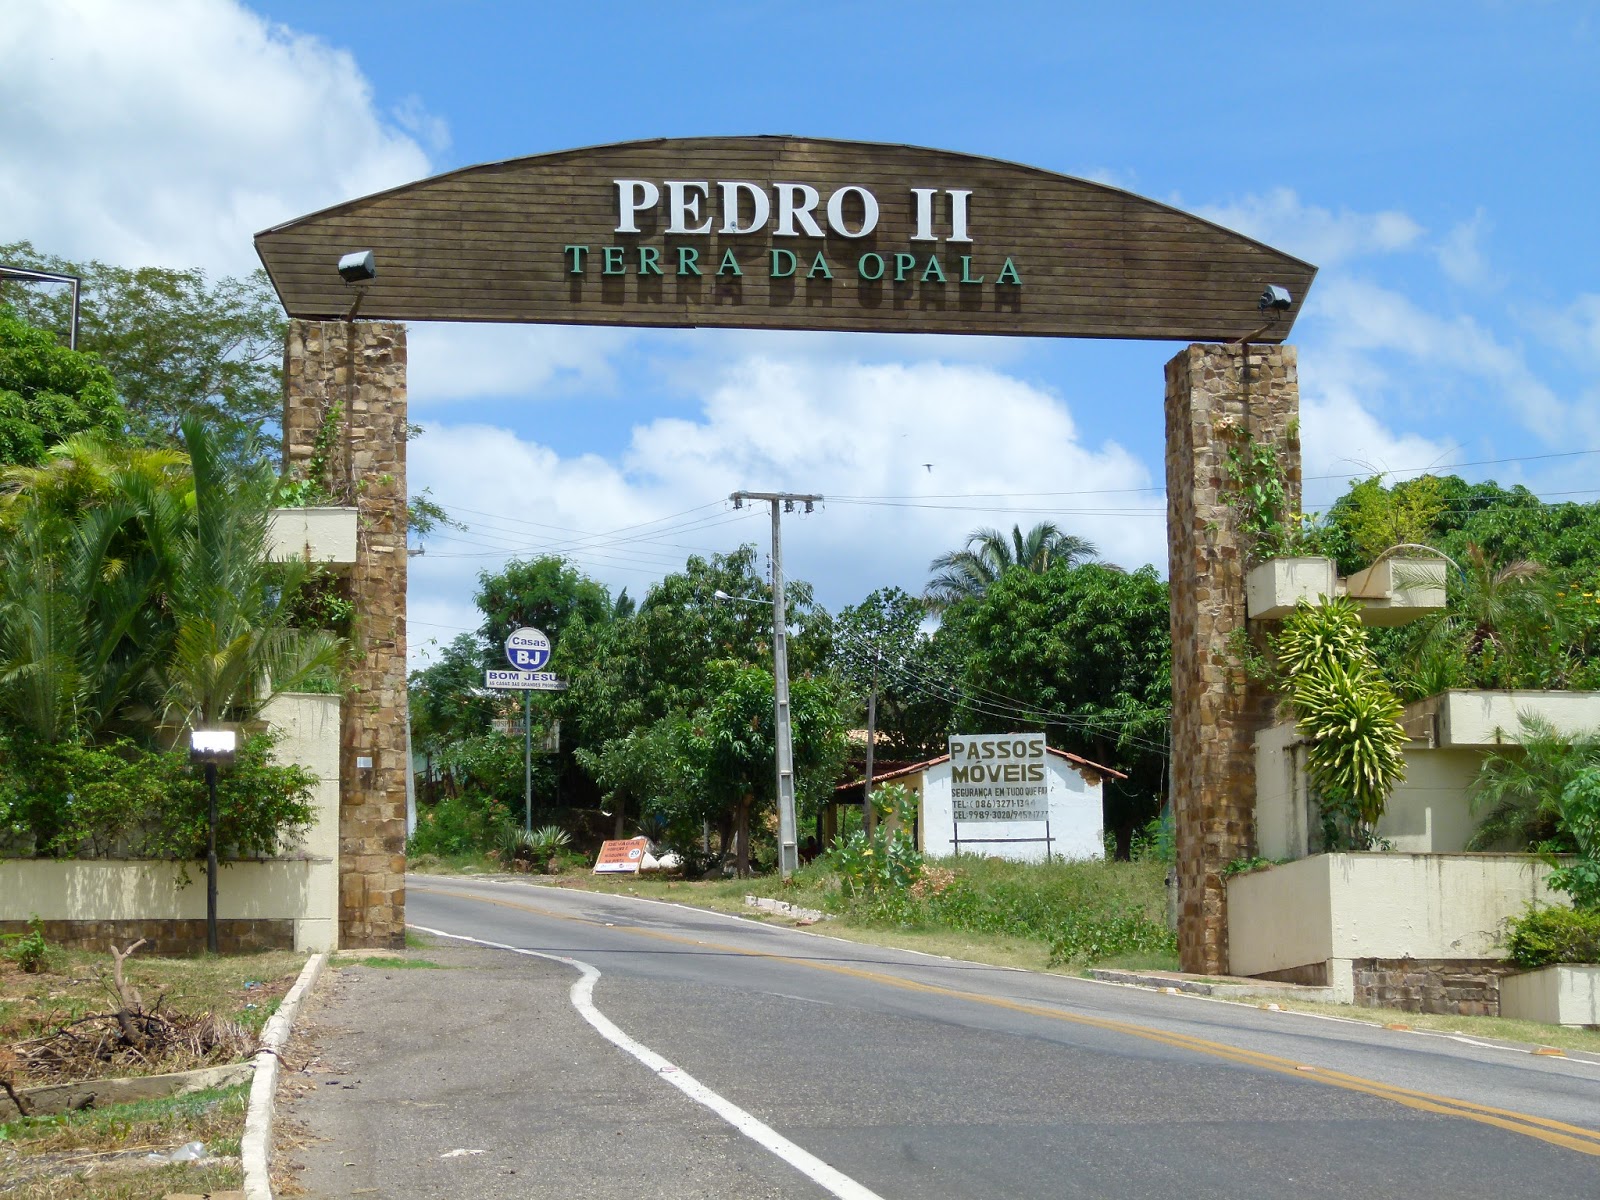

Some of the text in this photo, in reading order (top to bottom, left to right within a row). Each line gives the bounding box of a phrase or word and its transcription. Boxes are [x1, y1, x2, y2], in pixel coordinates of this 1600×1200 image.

[613, 179, 973, 243] PEDRO II
[564, 245, 1022, 285] TERRA DA OPALA
[512, 637, 546, 647] Casas
[517, 650, 540, 665] BJ
[489, 672, 566, 682] BOM JESU
[951, 740, 1044, 760] PASSOS
[952, 760, 1045, 784] MÓVEIS
[952, 787, 992, 799] SEGURANÇA
[995, 787, 1005, 797] EM
[1007, 786, 1024, 797] TUDO
[1025, 786, 1037, 796] QUE
